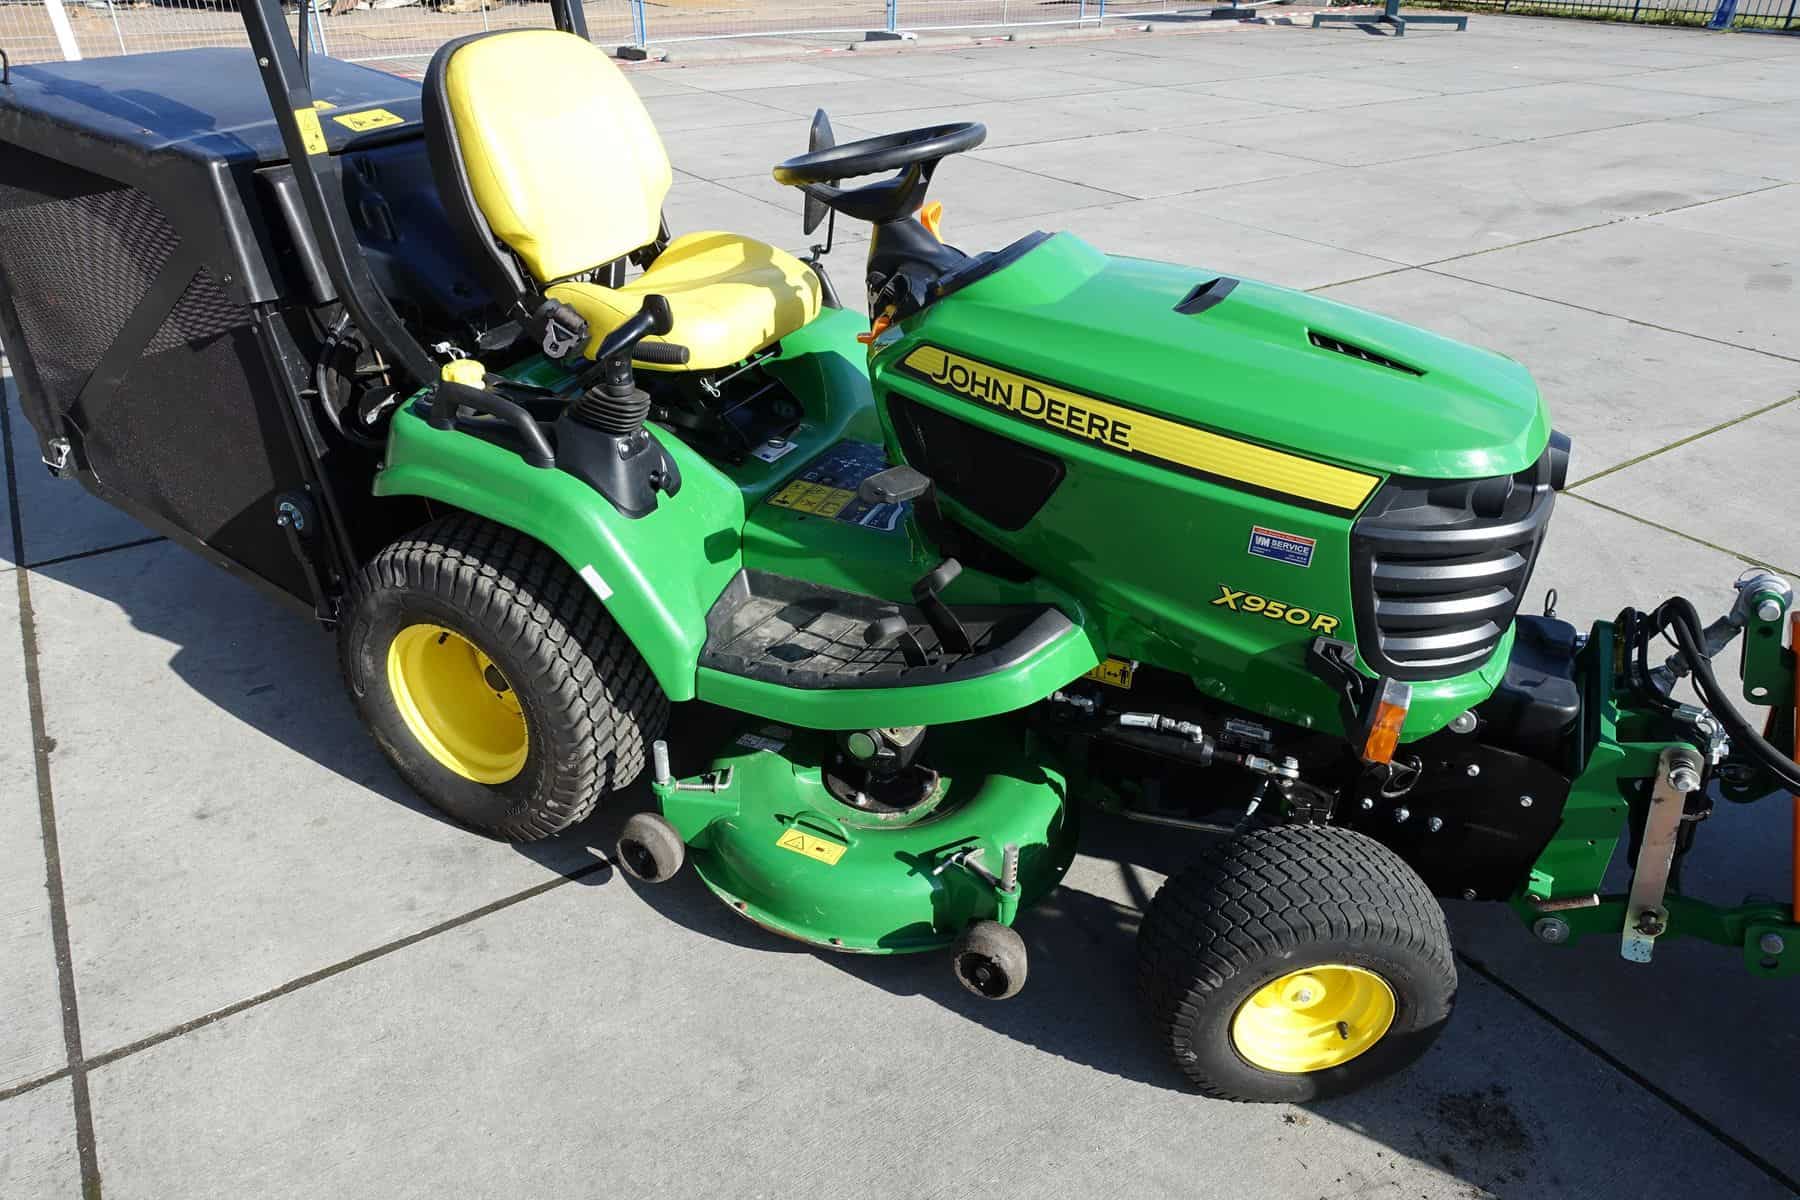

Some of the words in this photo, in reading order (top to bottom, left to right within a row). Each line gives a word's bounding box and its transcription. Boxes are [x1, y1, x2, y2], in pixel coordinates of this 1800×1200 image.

[932, 355, 1013, 406] JOHN
[1020, 383, 1132, 447] DEERE
[1271, 539, 1310, 554] SERVICE
